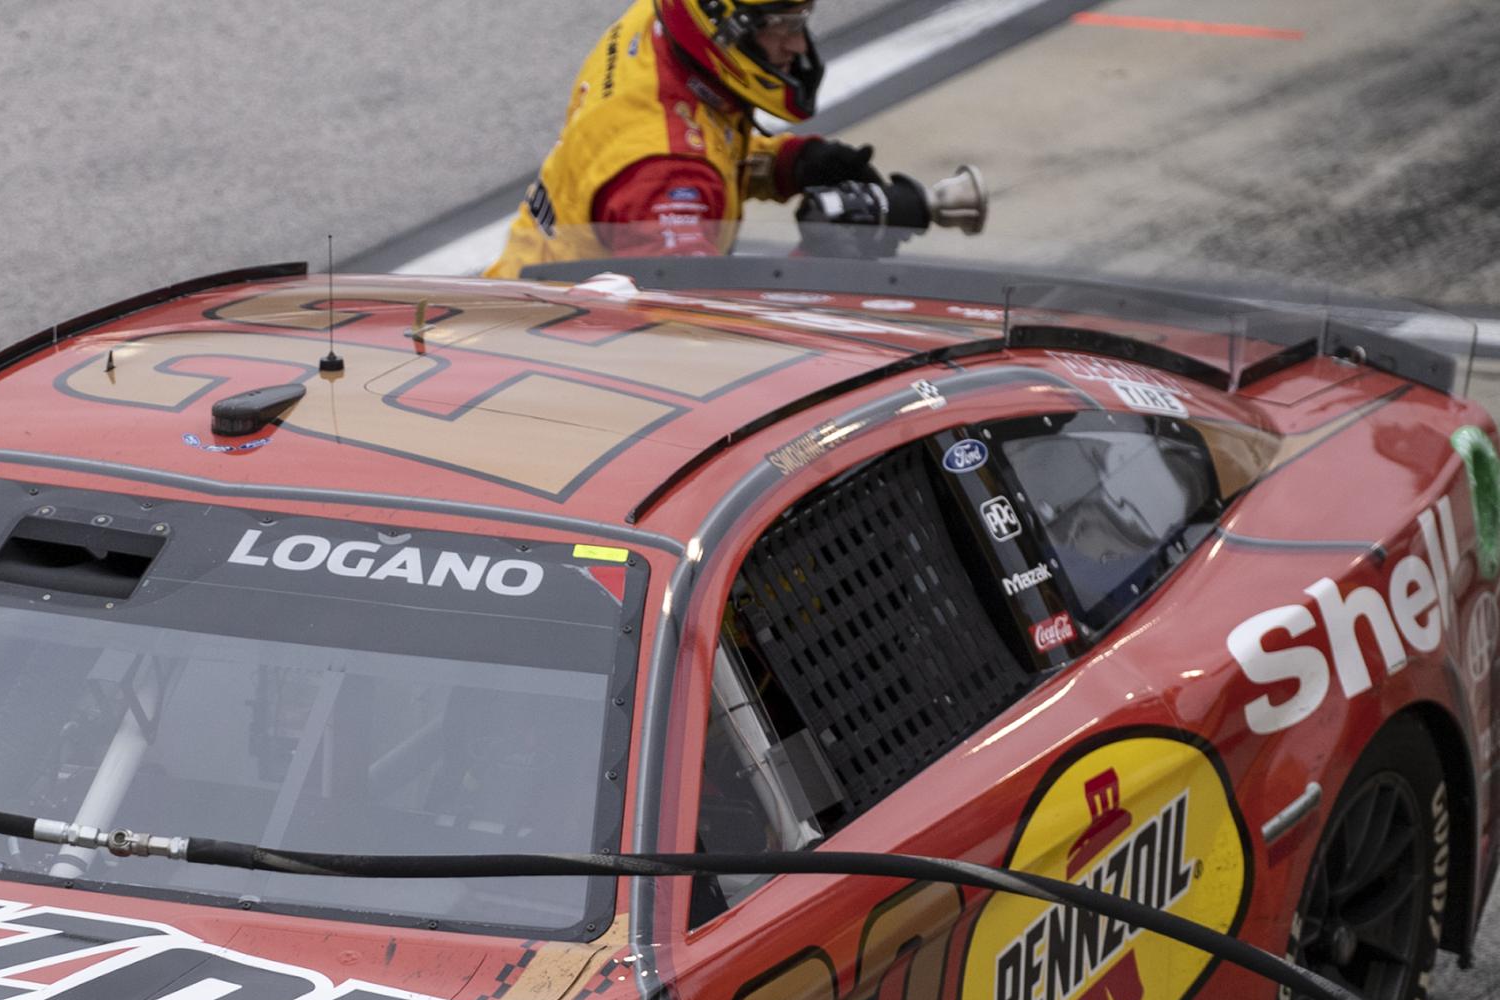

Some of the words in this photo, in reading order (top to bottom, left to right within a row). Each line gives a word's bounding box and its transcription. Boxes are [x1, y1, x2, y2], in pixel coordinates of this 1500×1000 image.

[1118, 384, 1178, 412] TIRE
[953, 443, 983, 468] Ford
[985, 502, 1017, 537] PPG
[227, 528, 544, 597] LOGANO
[1001, 562, 1053, 596] Mazak
[1226, 494, 1461, 735] Shell
